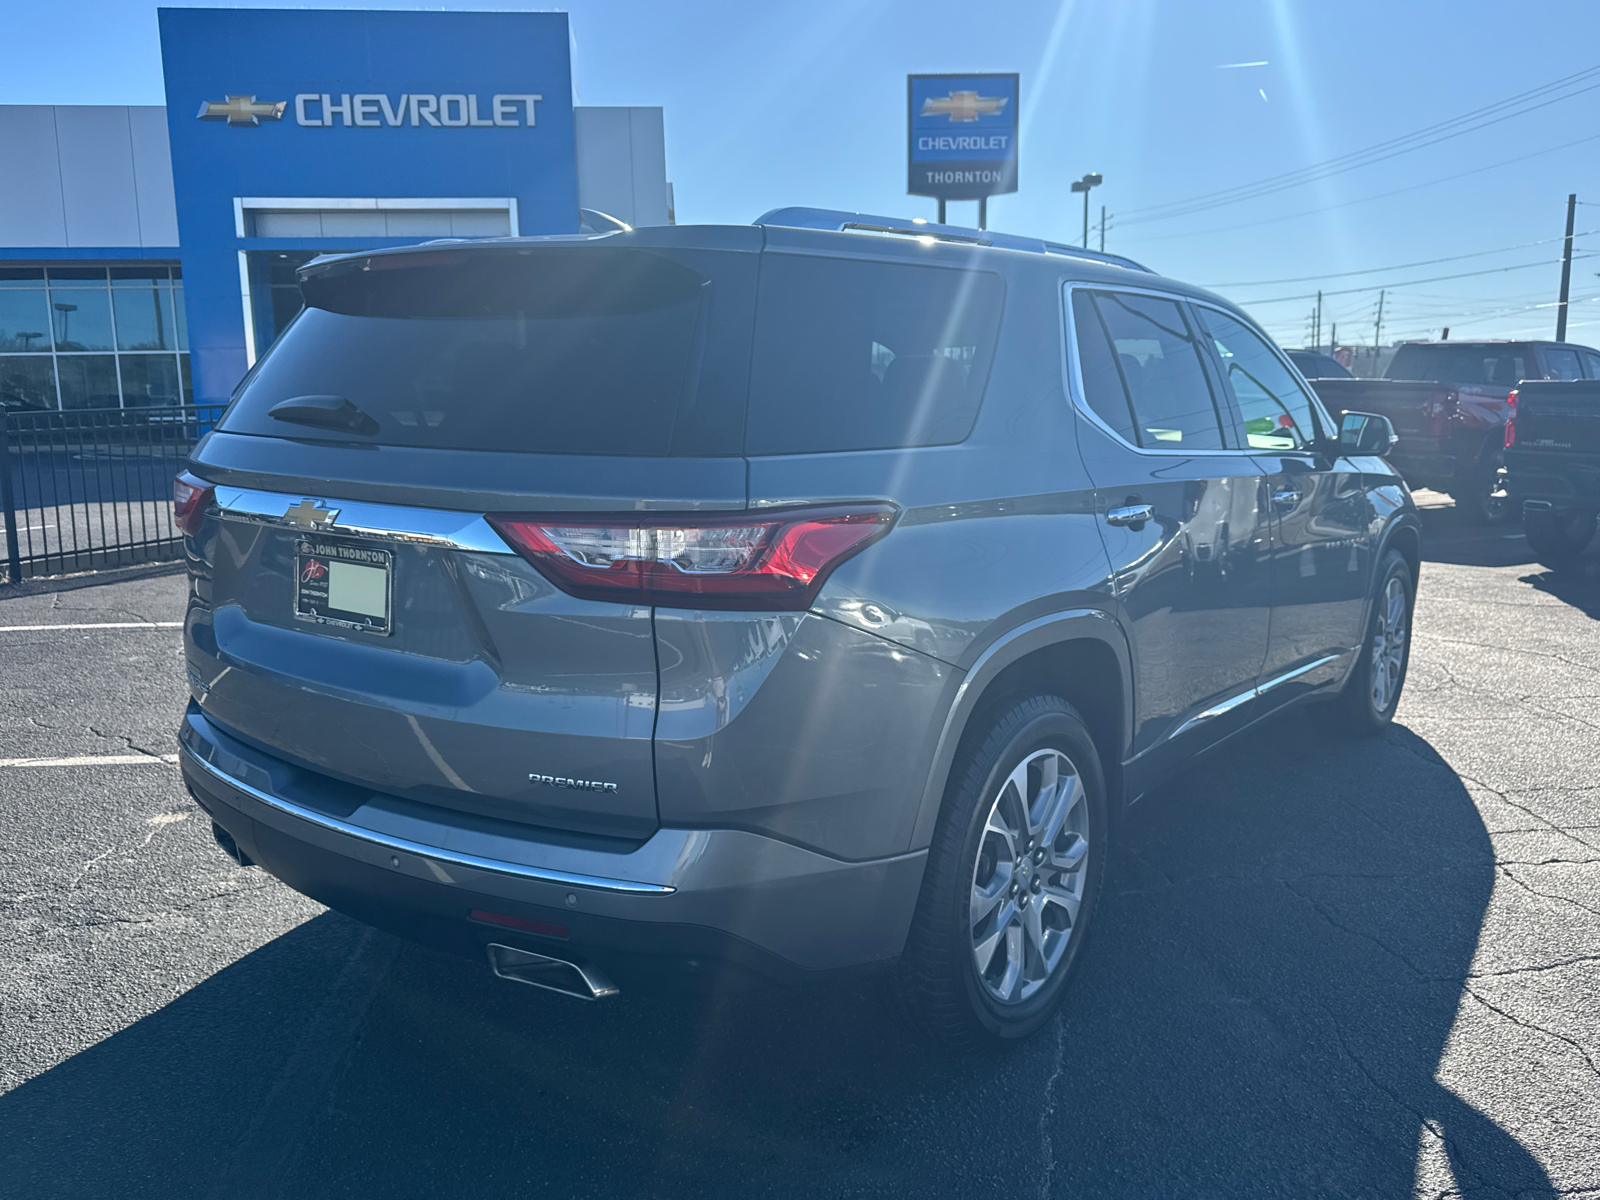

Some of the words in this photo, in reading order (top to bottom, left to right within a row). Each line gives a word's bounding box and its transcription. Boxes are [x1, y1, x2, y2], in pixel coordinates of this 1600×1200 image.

[295, 94, 542, 127] CHEVROLET
[918, 136, 1008, 150] CHEVROLET
[926, 171, 1001, 183] THORNTON
[315, 544, 337, 556] JOHN
[338, 548, 385, 563] THORNTON
[326, 620, 353, 629] CHEVROLET
[528, 773, 618, 794] PREMIER
